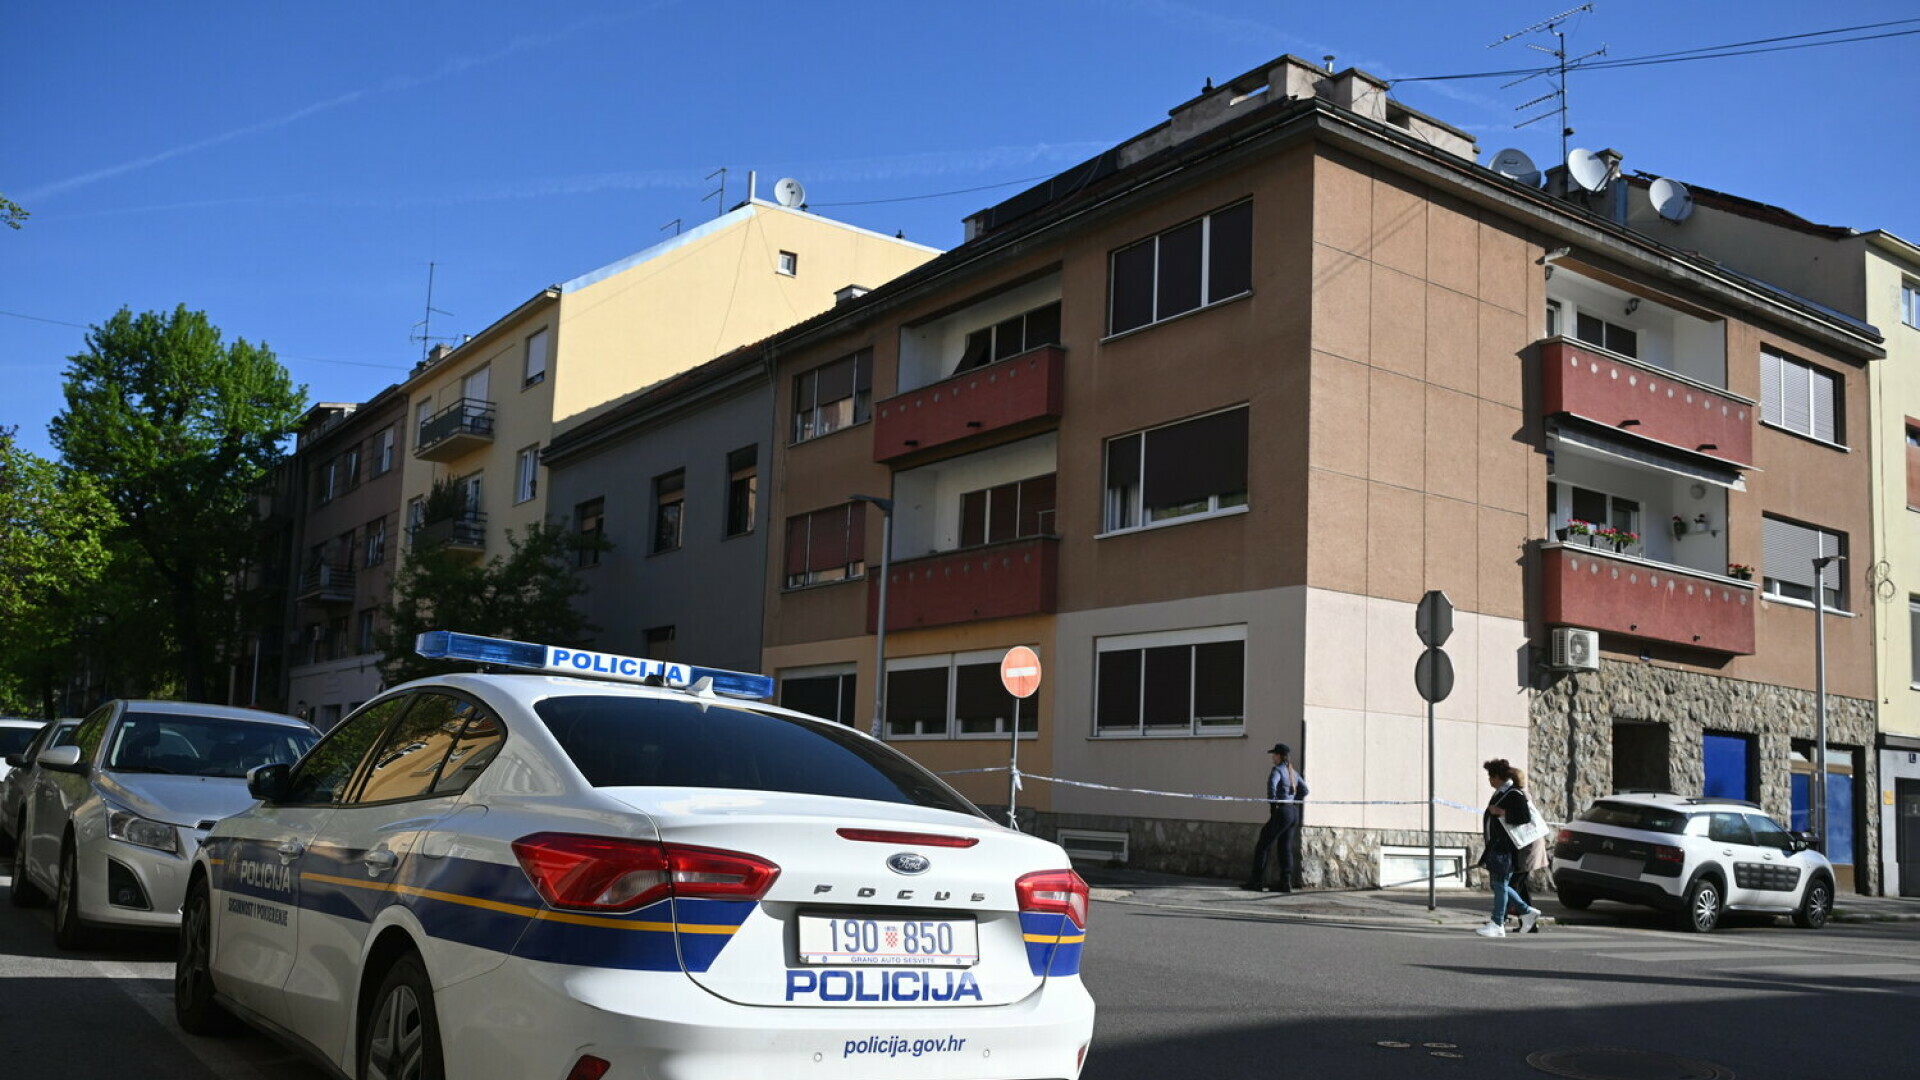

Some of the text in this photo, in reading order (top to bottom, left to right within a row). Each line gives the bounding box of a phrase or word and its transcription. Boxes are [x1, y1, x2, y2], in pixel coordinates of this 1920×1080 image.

[552, 649, 683, 682] POLICIJA
[240, 859, 290, 893] POLICIJA
[813, 884, 985, 902] FOCUS
[830, 918, 953, 955] 190 850
[851, 956, 879, 964] GRAND
[785, 969, 983, 1002] POLICIJA
[843, 1034, 966, 1059] policija.gov.hr
